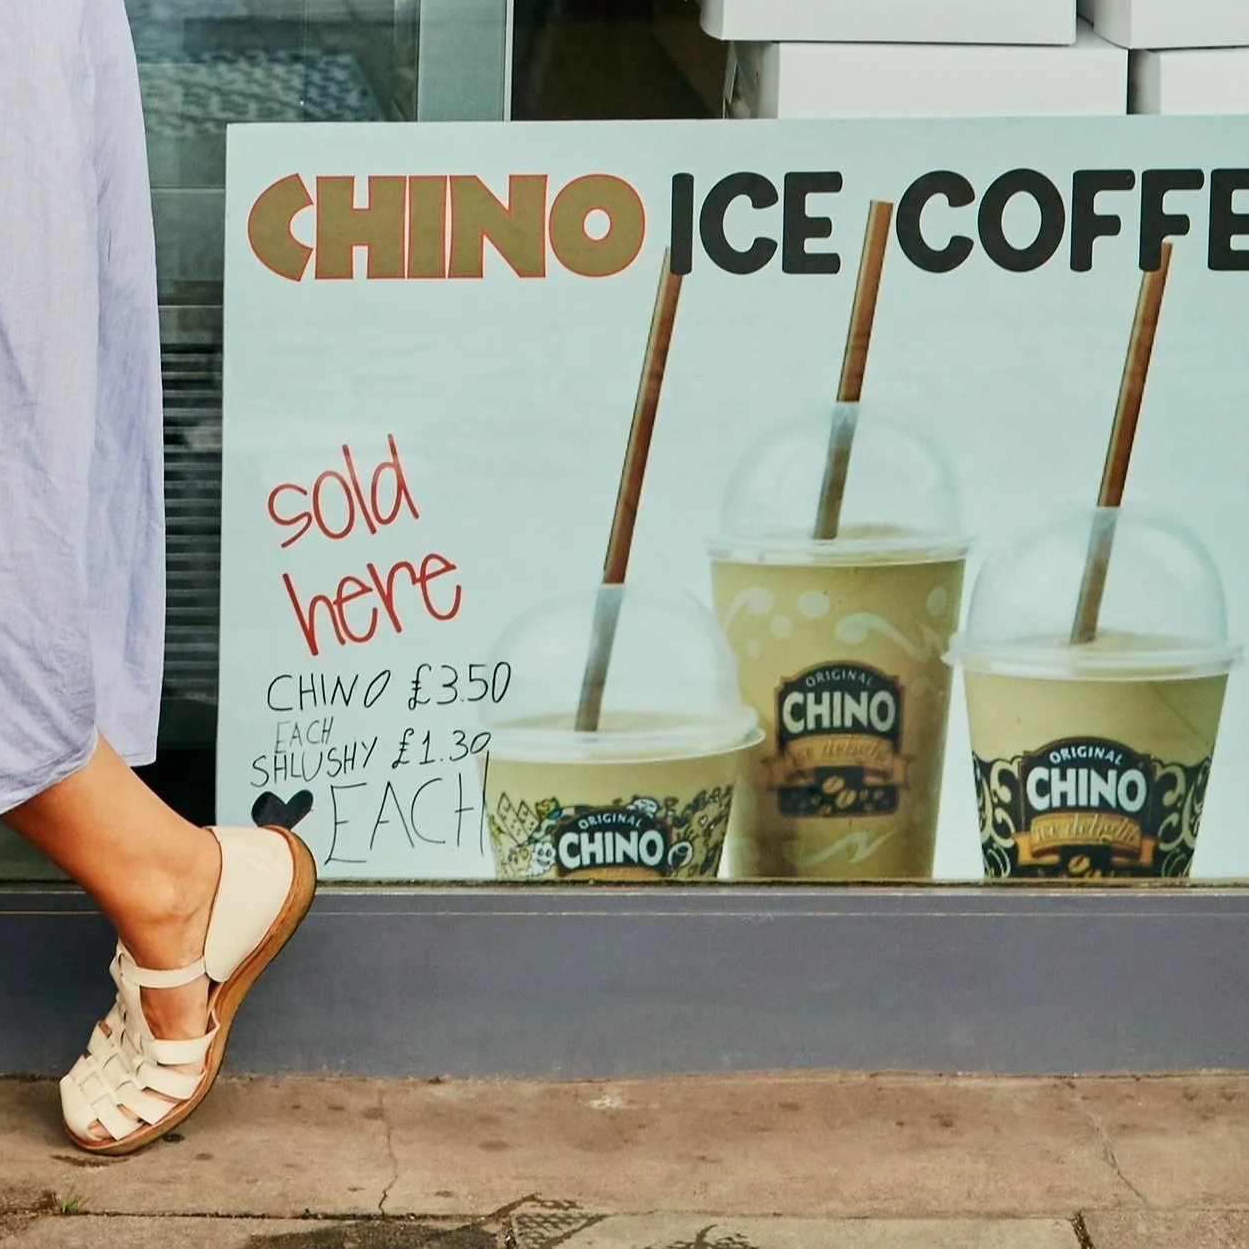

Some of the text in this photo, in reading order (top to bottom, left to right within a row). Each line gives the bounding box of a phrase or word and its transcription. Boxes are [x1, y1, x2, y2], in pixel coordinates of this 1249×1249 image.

[247, 173, 646, 282] CHINO
[670, 171, 842, 276] ICE
[268, 433, 420, 548] sold
[282, 553, 462, 657] here
[267, 661, 512, 711] CHINO £3.50
[805, 668, 875, 688] ORIGINAL
[275, 716, 334, 754] EACH
[782, 690, 896, 735] CHINO
[250, 727, 492, 788] SHLUSHY £1.30
[1049, 745, 1123, 767] ORIGINAL
[324, 750, 491, 865] EACH
[1026, 766, 1147, 813] CHINO
[577, 812, 642, 830] ORIGINAL
[558, 830, 665, 869] CHINO
